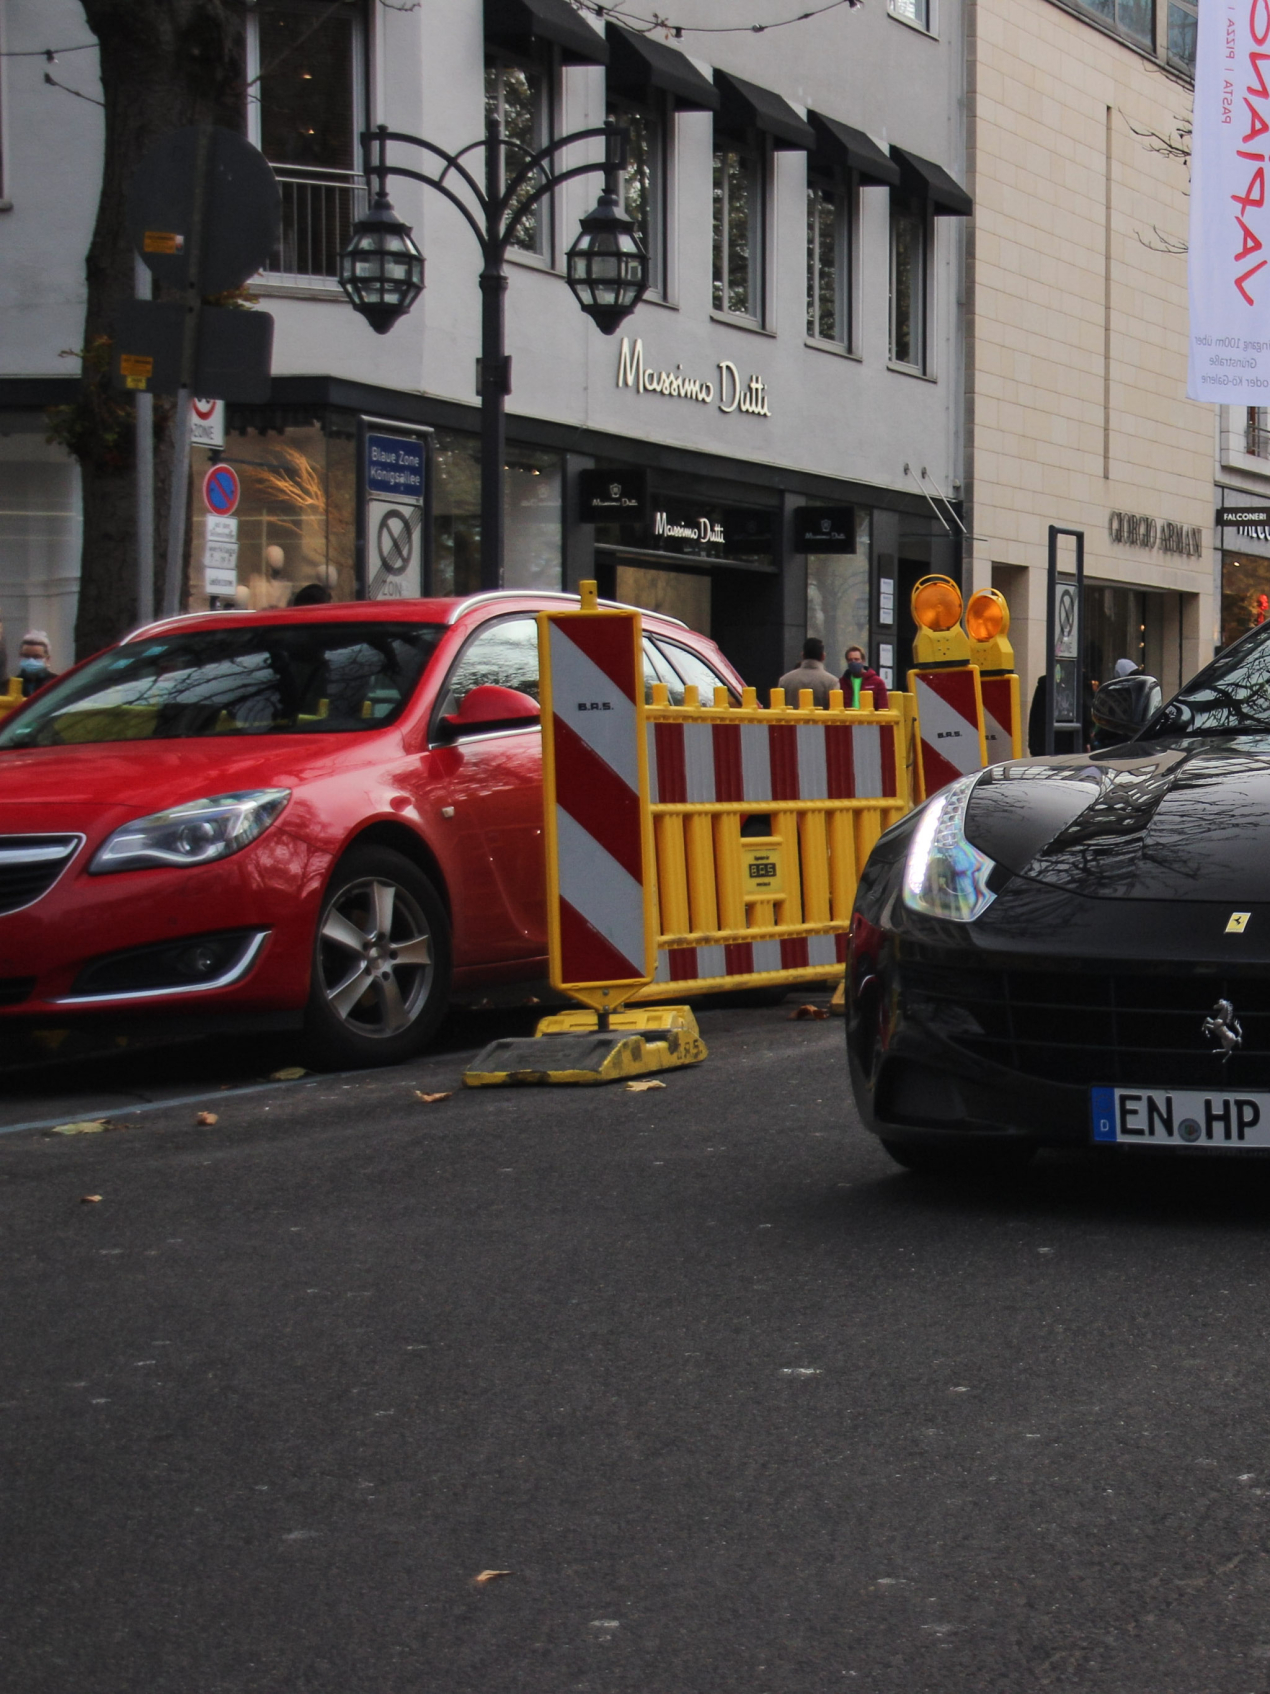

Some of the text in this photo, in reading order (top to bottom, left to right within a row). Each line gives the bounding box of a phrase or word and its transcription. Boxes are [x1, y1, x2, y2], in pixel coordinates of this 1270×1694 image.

[617, 337, 772, 417] Massimo Dutti
[371, 446, 420, 467] Blaue Zone
[370, 466, 421, 486] Königsallee
[655, 512, 726, 543] Massimo Dutti
[1109, 511, 1157, 550] GIORGIO
[1160, 521, 1203, 558] ARMANI
[578, 702, 614, 711] B.A.S.
[1100, 1119, 1109, 1132] D
[1119, 1094, 1175, 1138] EN
[1204, 1098, 1260, 1140] HP
